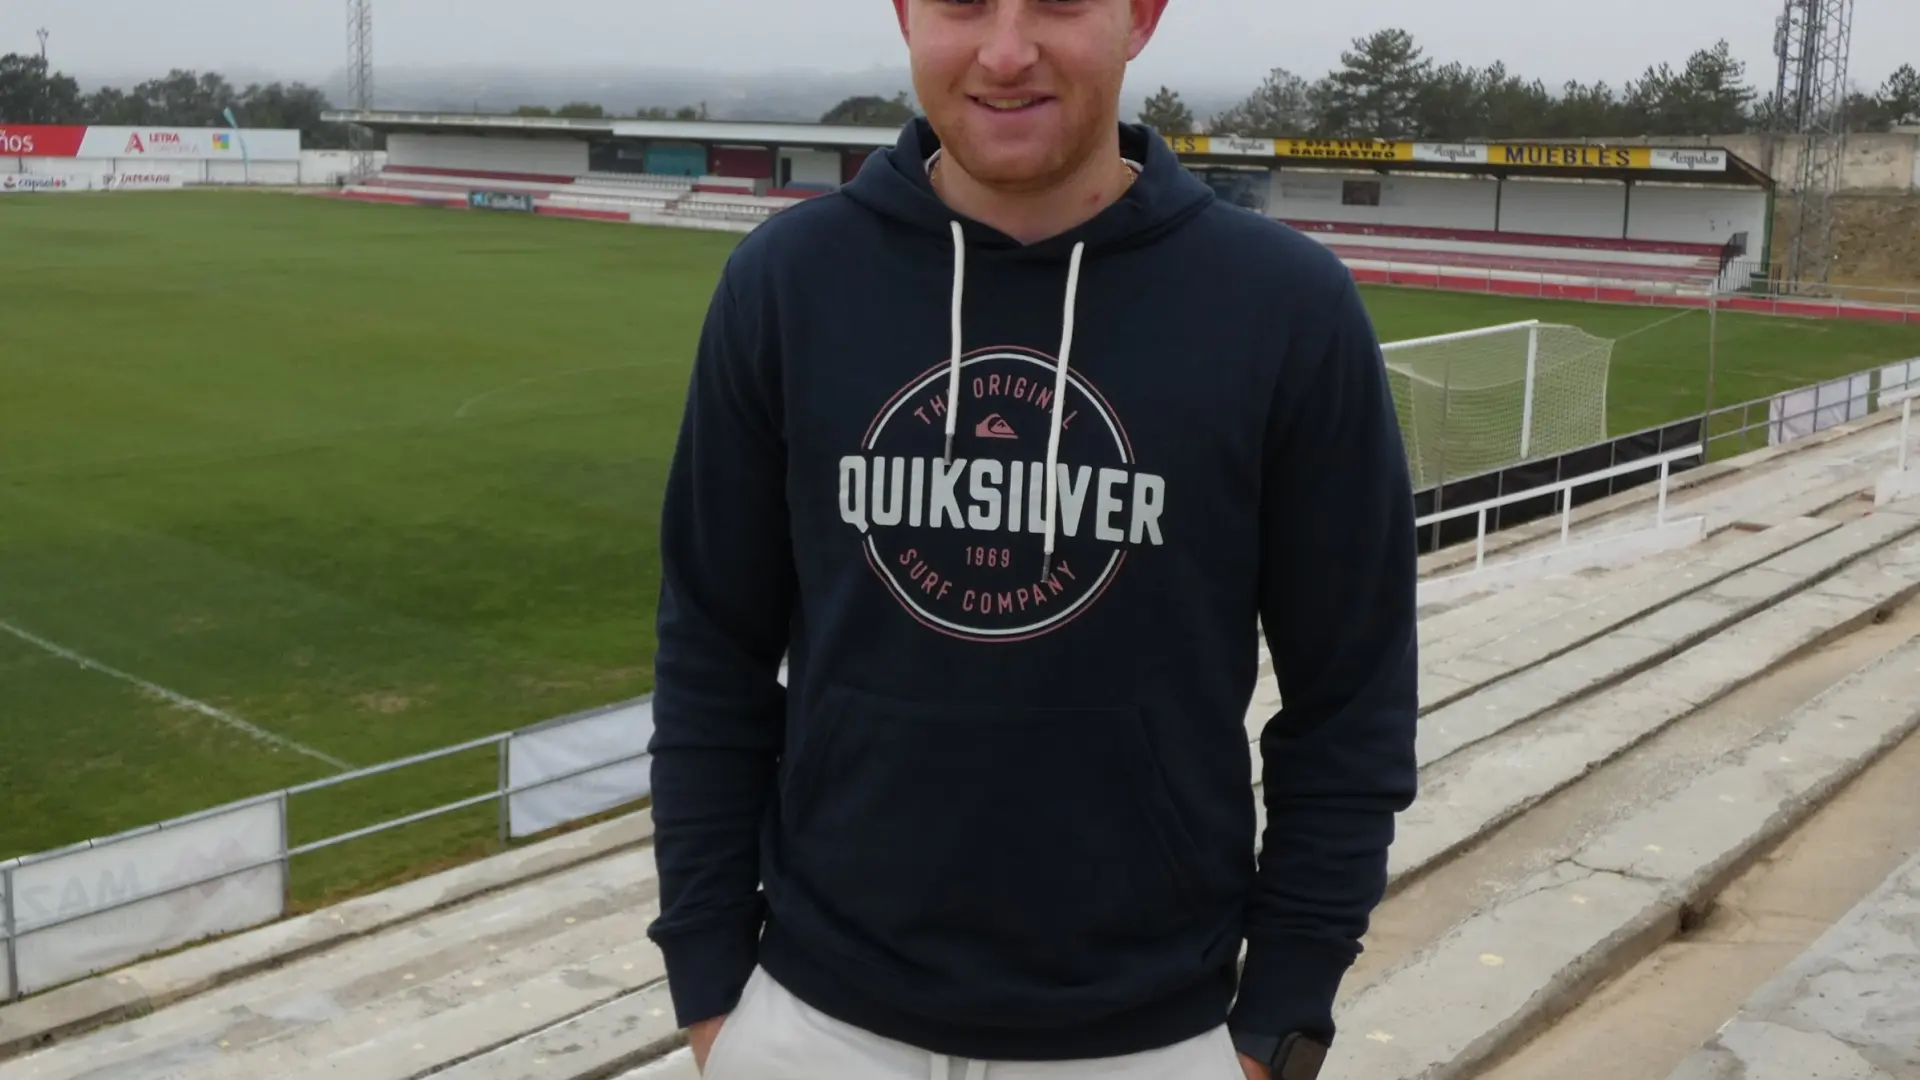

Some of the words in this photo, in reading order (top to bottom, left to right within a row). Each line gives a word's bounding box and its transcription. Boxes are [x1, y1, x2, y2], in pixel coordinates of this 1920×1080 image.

[149, 131, 180, 143] LETRA
[1290, 148, 1396, 158] BARBASTRO
[1505, 145, 1631, 167] MUEBLES
[914, 388, 959, 425] TH
[973, 374, 1078, 430] ORIGINL
[839, 455, 1166, 546] QUIKSILVER
[966, 546, 1011, 568] 1969
[900, 549, 953, 600] SURF
[962, 560, 1076, 615] COMPANY
